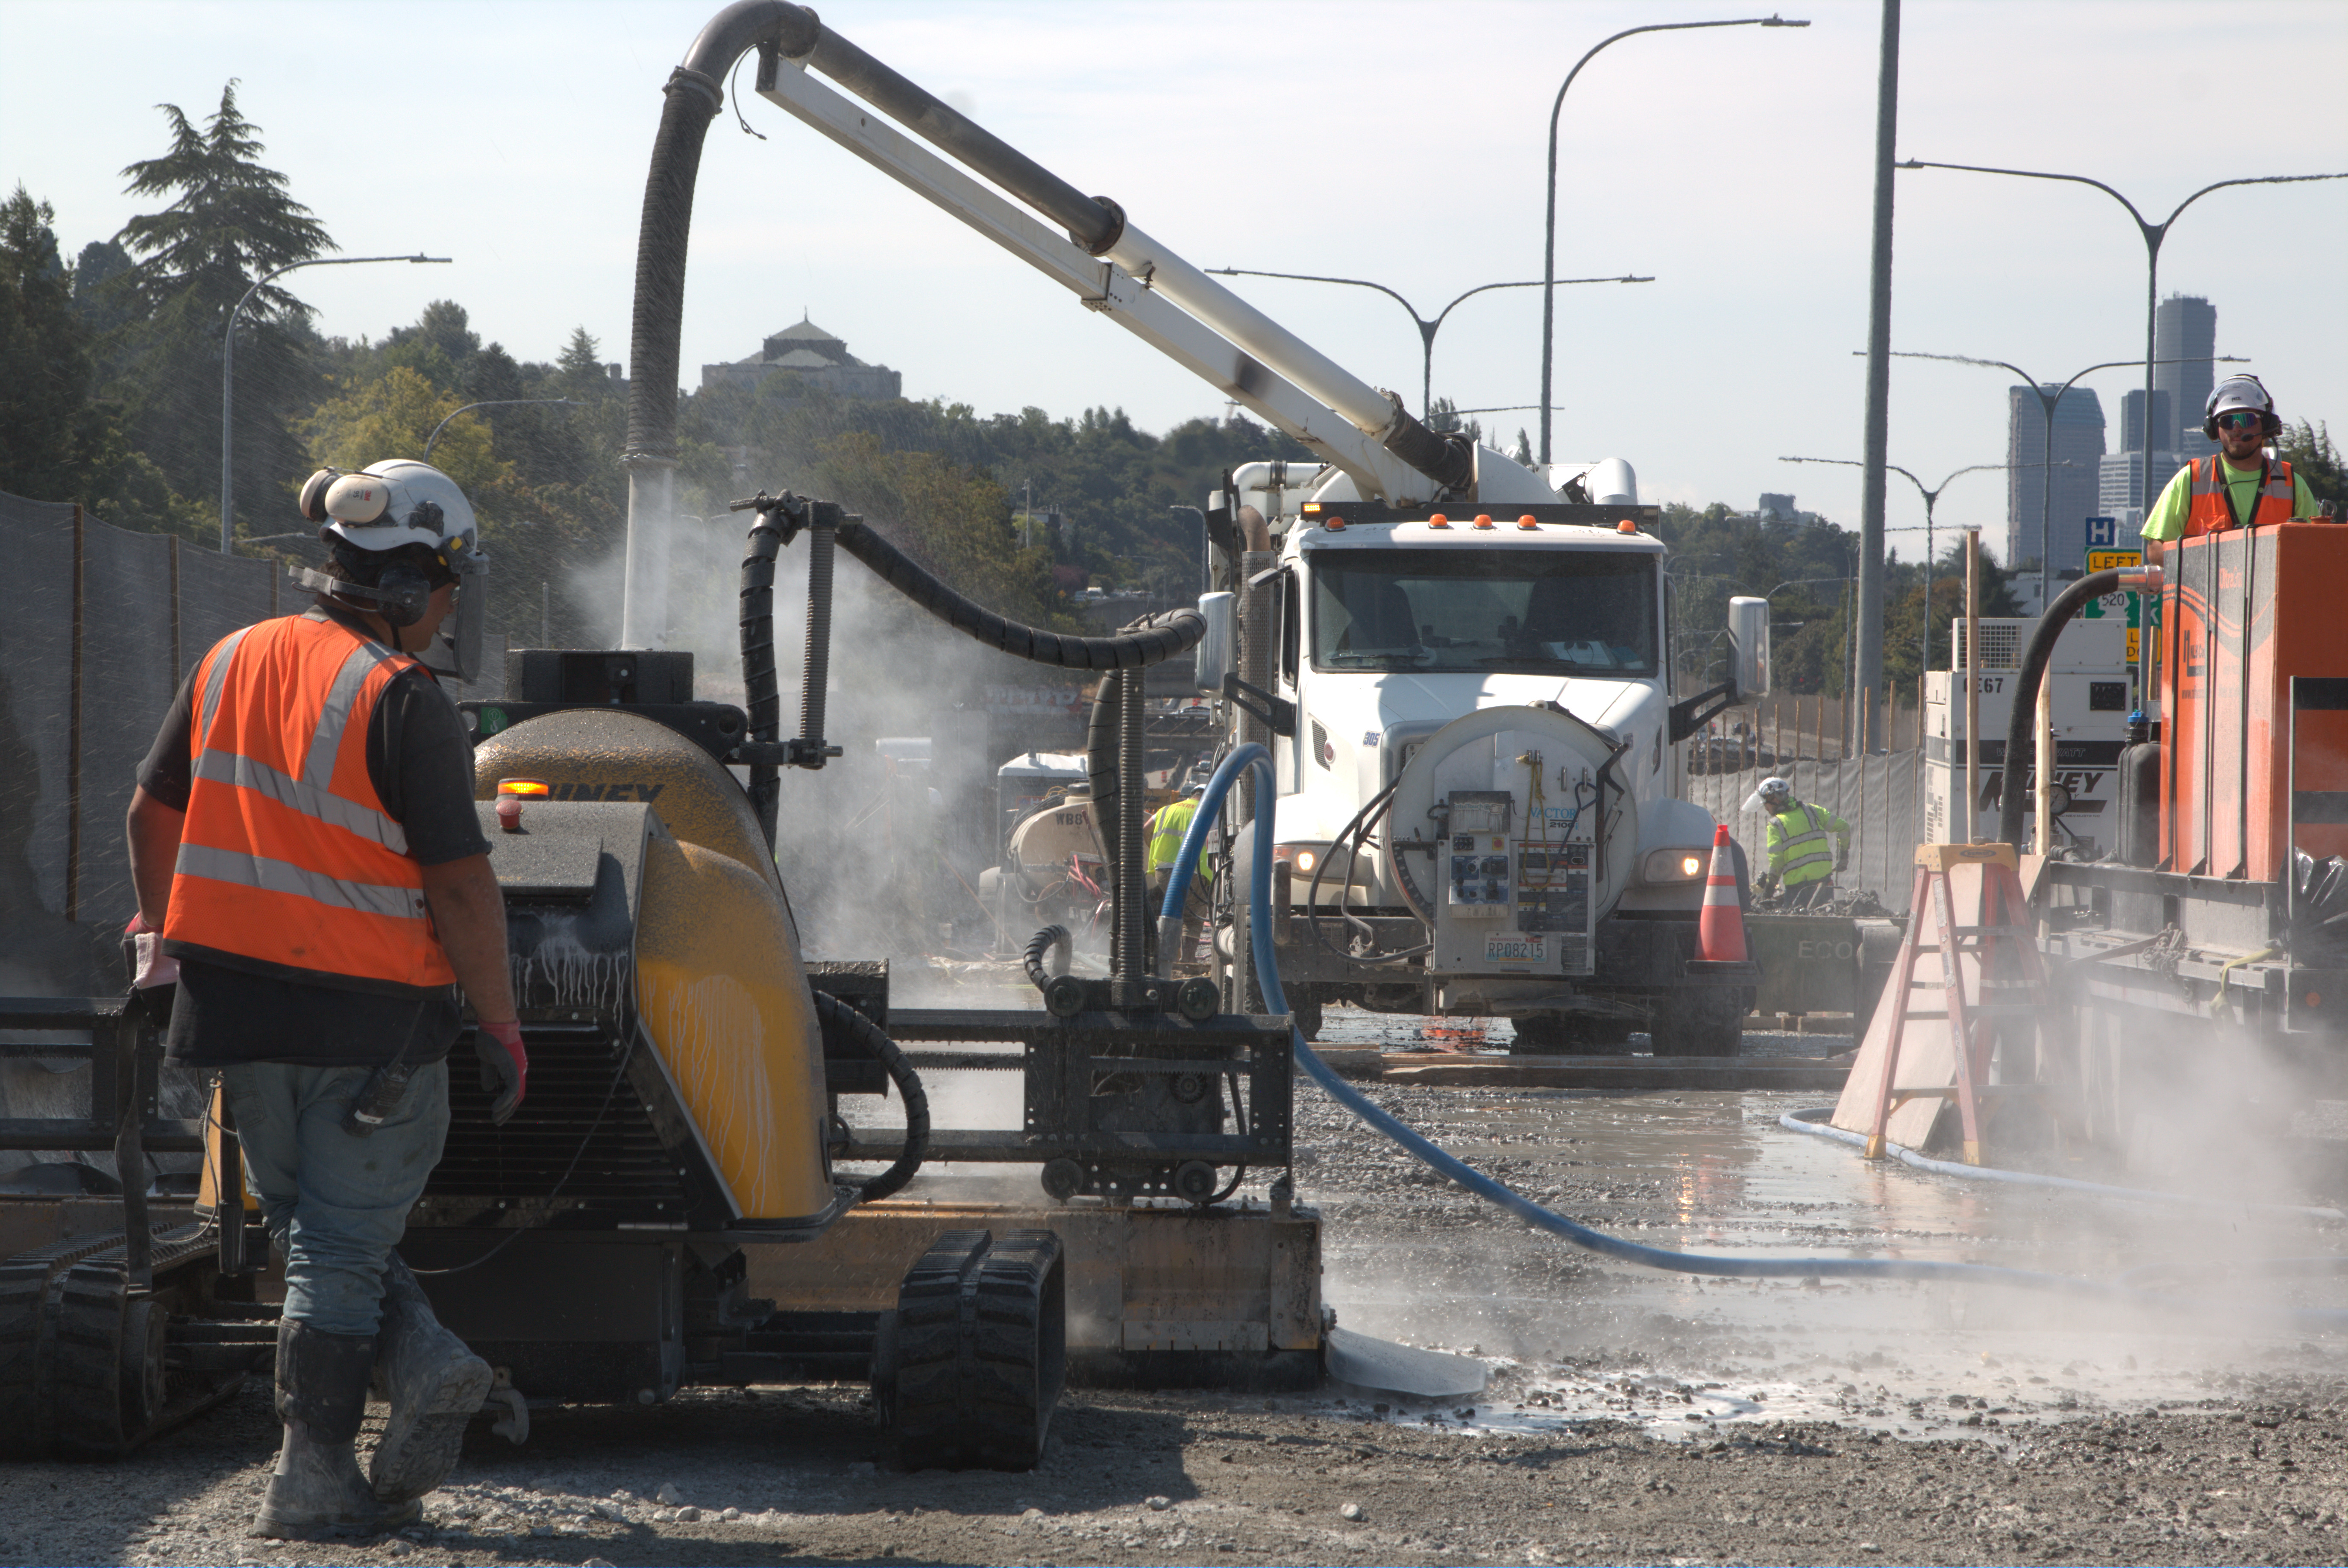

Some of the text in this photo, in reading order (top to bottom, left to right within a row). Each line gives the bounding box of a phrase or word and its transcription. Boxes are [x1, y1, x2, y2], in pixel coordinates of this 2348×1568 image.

[364, 490, 371, 501] 3M
[2091, 521, 2109, 543] H
[2093, 556, 2137, 569] LEFT
[2102, 593, 2125, 606] 520
[1363, 731, 1382, 747] 305
[1056, 813, 1083, 825] WB8
[1530, 807, 1576, 819] VACTOR
[1489, 943, 1543, 958] RP08215
